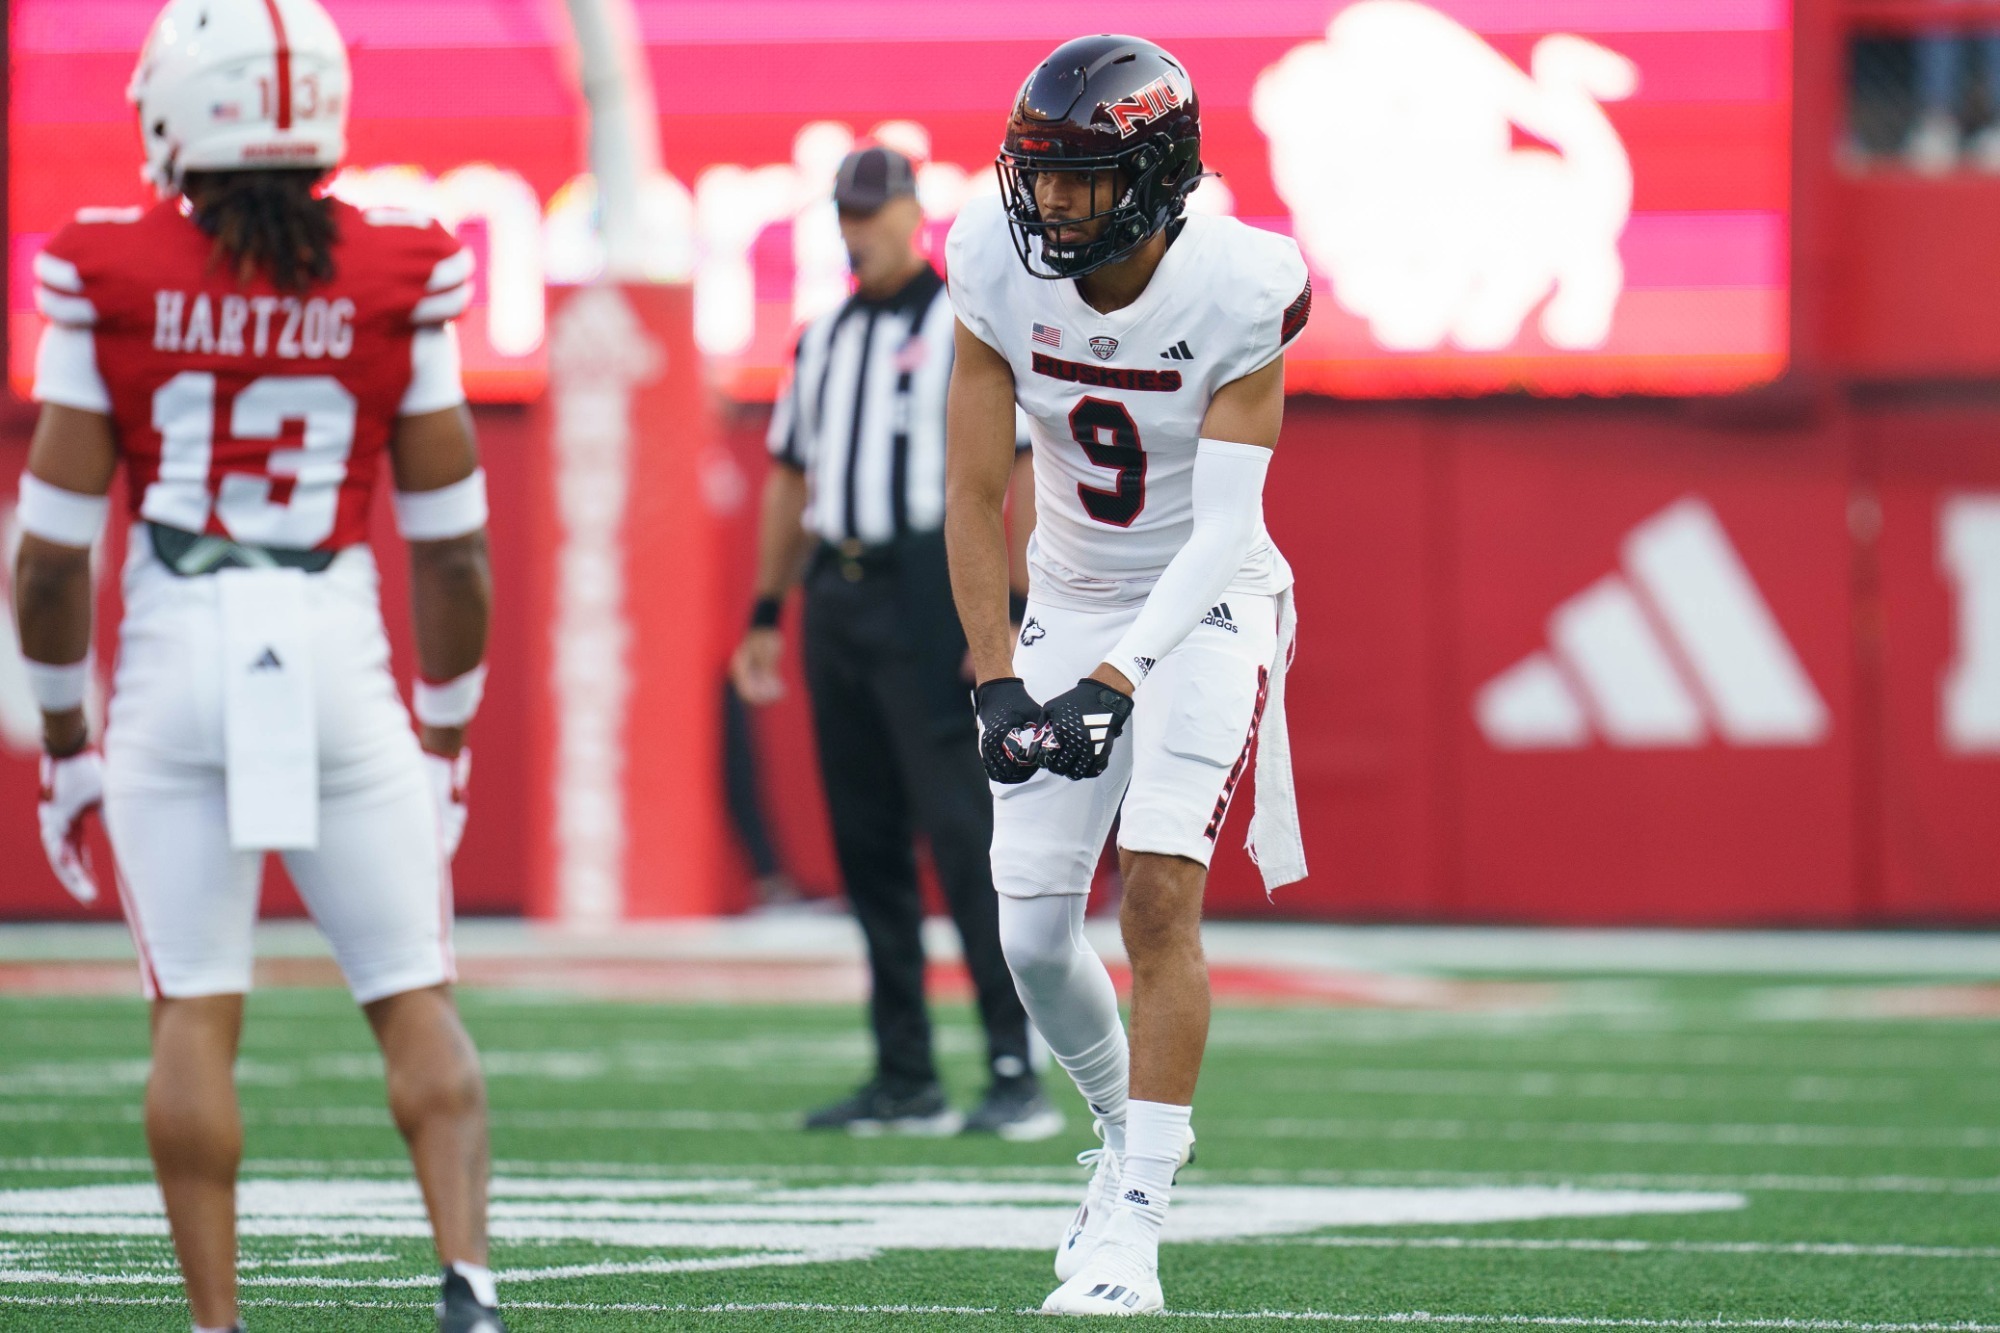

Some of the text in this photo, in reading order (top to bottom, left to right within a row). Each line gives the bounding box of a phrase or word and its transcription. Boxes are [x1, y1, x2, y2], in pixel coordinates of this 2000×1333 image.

[1105, 70, 1185, 139] NIU
[153, 290, 355, 359] HARTZOG
[1032, 351, 1182, 392] HUSKIES
[140, 371, 358, 549] 13
[1068, 394, 1147, 528] 9
[1124, 1193, 1149, 1205] adidas
